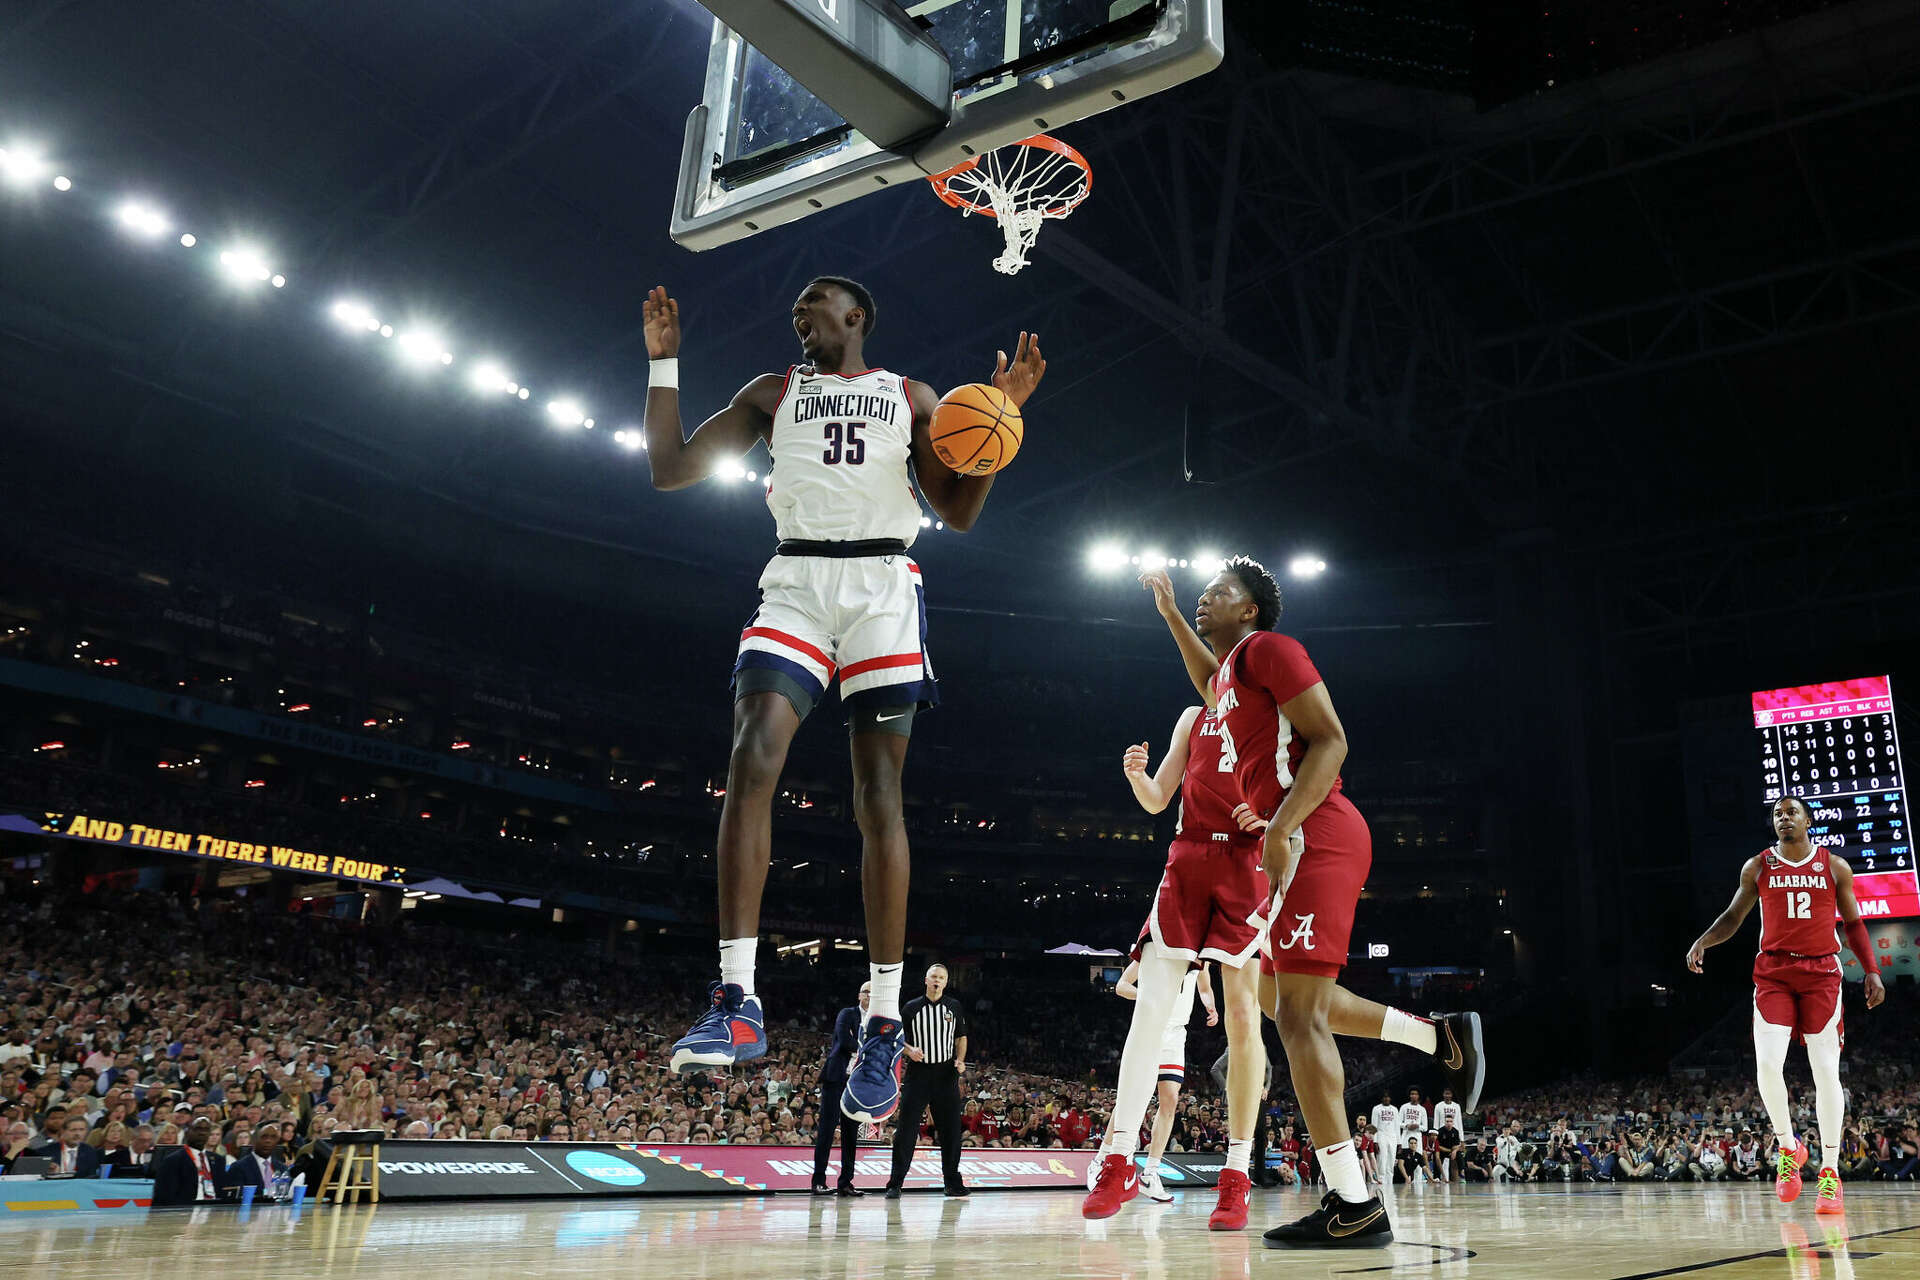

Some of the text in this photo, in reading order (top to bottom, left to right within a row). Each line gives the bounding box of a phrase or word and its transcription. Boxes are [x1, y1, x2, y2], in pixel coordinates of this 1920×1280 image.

[794, 394, 897, 426] CONNECTICUT
[823, 422, 866, 465] 35
[1781, 700, 1890, 720] PTS REB AST STL BLK FLS
[1762, 714, 1890, 739] 1 14 3 3 0 1 3
[1763, 729, 1892, 754] 2 13 11 0 0 0 3
[1762, 745, 1894, 769] 10 0 1 1 0 0 0
[1764, 761, 1895, 784] 12 6 0 0 1 1 1
[1766, 776, 1897, 799] 55 13 3 3 1 0 1
[1854, 796, 1870, 804] REB
[1884, 793, 1900, 801] BLK
[1855, 805, 1871, 817] 22
[1889, 802, 1898, 813] 4
[1857, 822, 1873, 831] AST
[1889, 819, 1902, 828] TO
[66, 815, 124, 842] AND
[130, 824, 192, 852] THEN
[197, 834, 267, 863] THERE
[272, 846, 328, 873] WERE
[1212, 833, 1228, 841] RTR
[1811, 829, 1901, 848] (56%) 8 6
[1861, 846, 1908, 857] STL POT
[1866, 855, 1905, 869] 2 6
[1769, 875, 1828, 889] ALABAMA
[1786, 891, 1812, 919] 12
[377, 1161, 536, 1175] POWERADE
[976, 1161, 1051, 1175] WERE
[1047, 1159, 1077, 1179] 4
